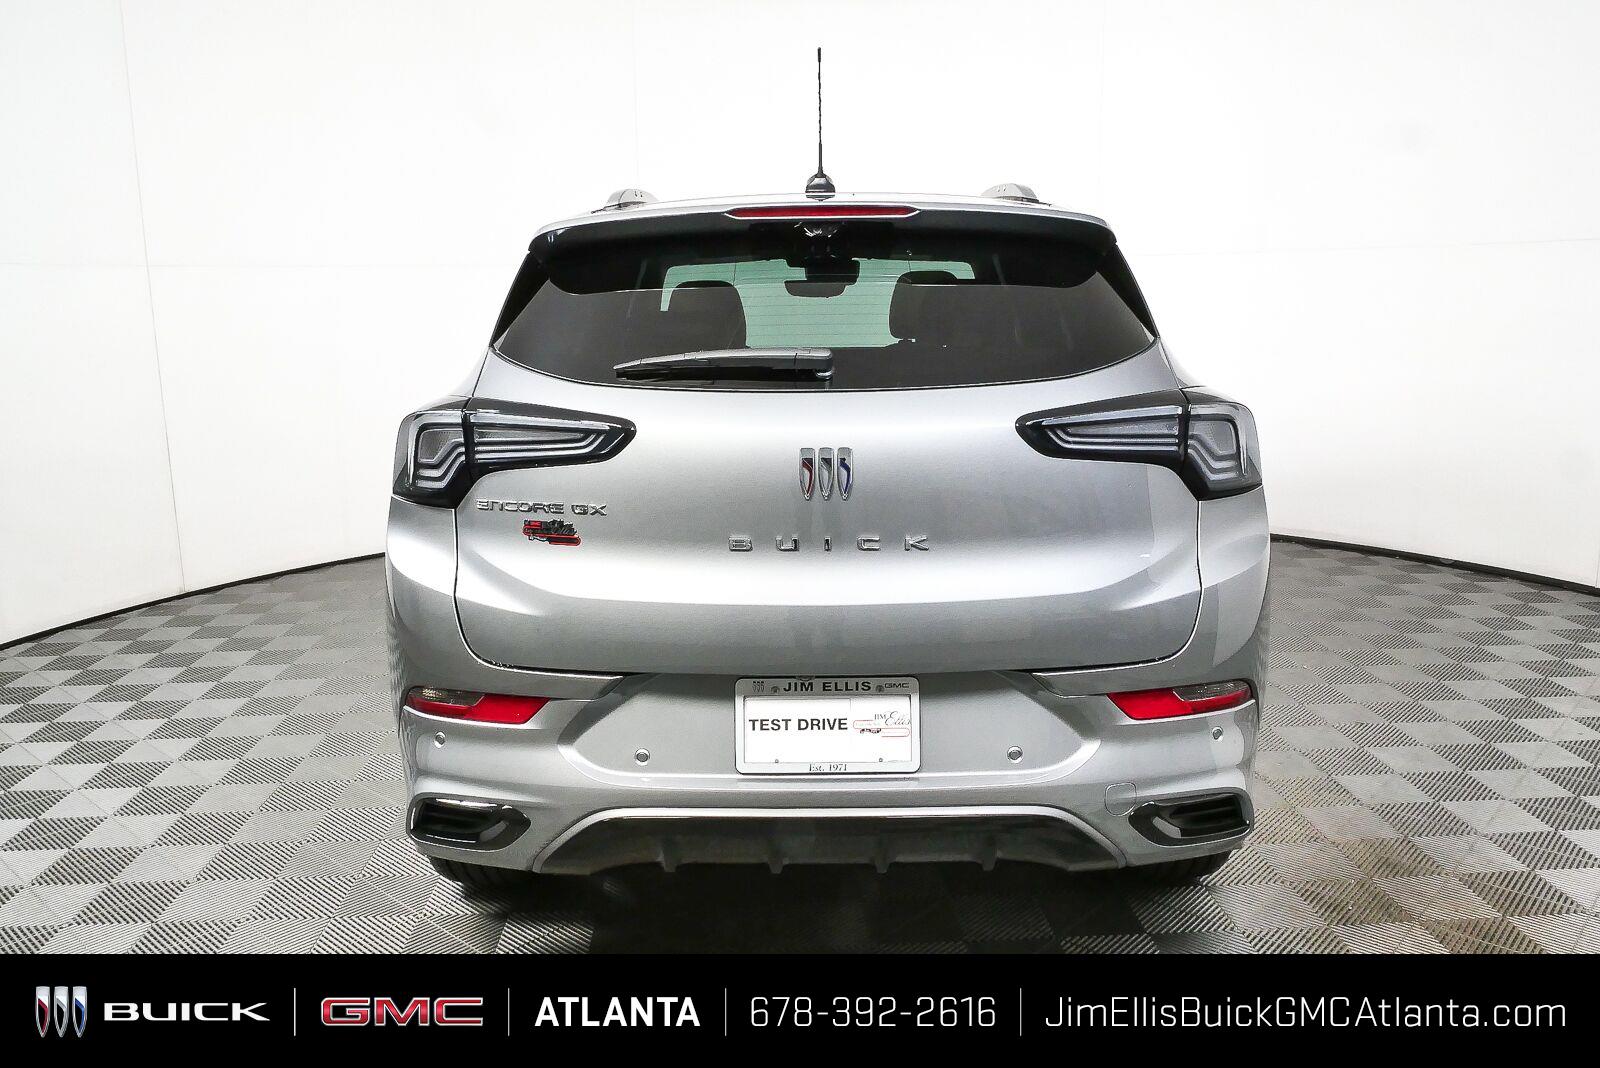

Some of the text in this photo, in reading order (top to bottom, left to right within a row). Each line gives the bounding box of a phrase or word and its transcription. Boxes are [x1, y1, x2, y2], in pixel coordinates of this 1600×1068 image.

[476, 499, 607, 516] ENCORE GX
[728, 535, 930, 551] BUICK
[783, 681, 872, 692] JIM ELLIS
[749, 718, 792, 731] TEST
[797, 717, 848, 731] DRIVE
[808, 763, 848, 772] Est. 1971
